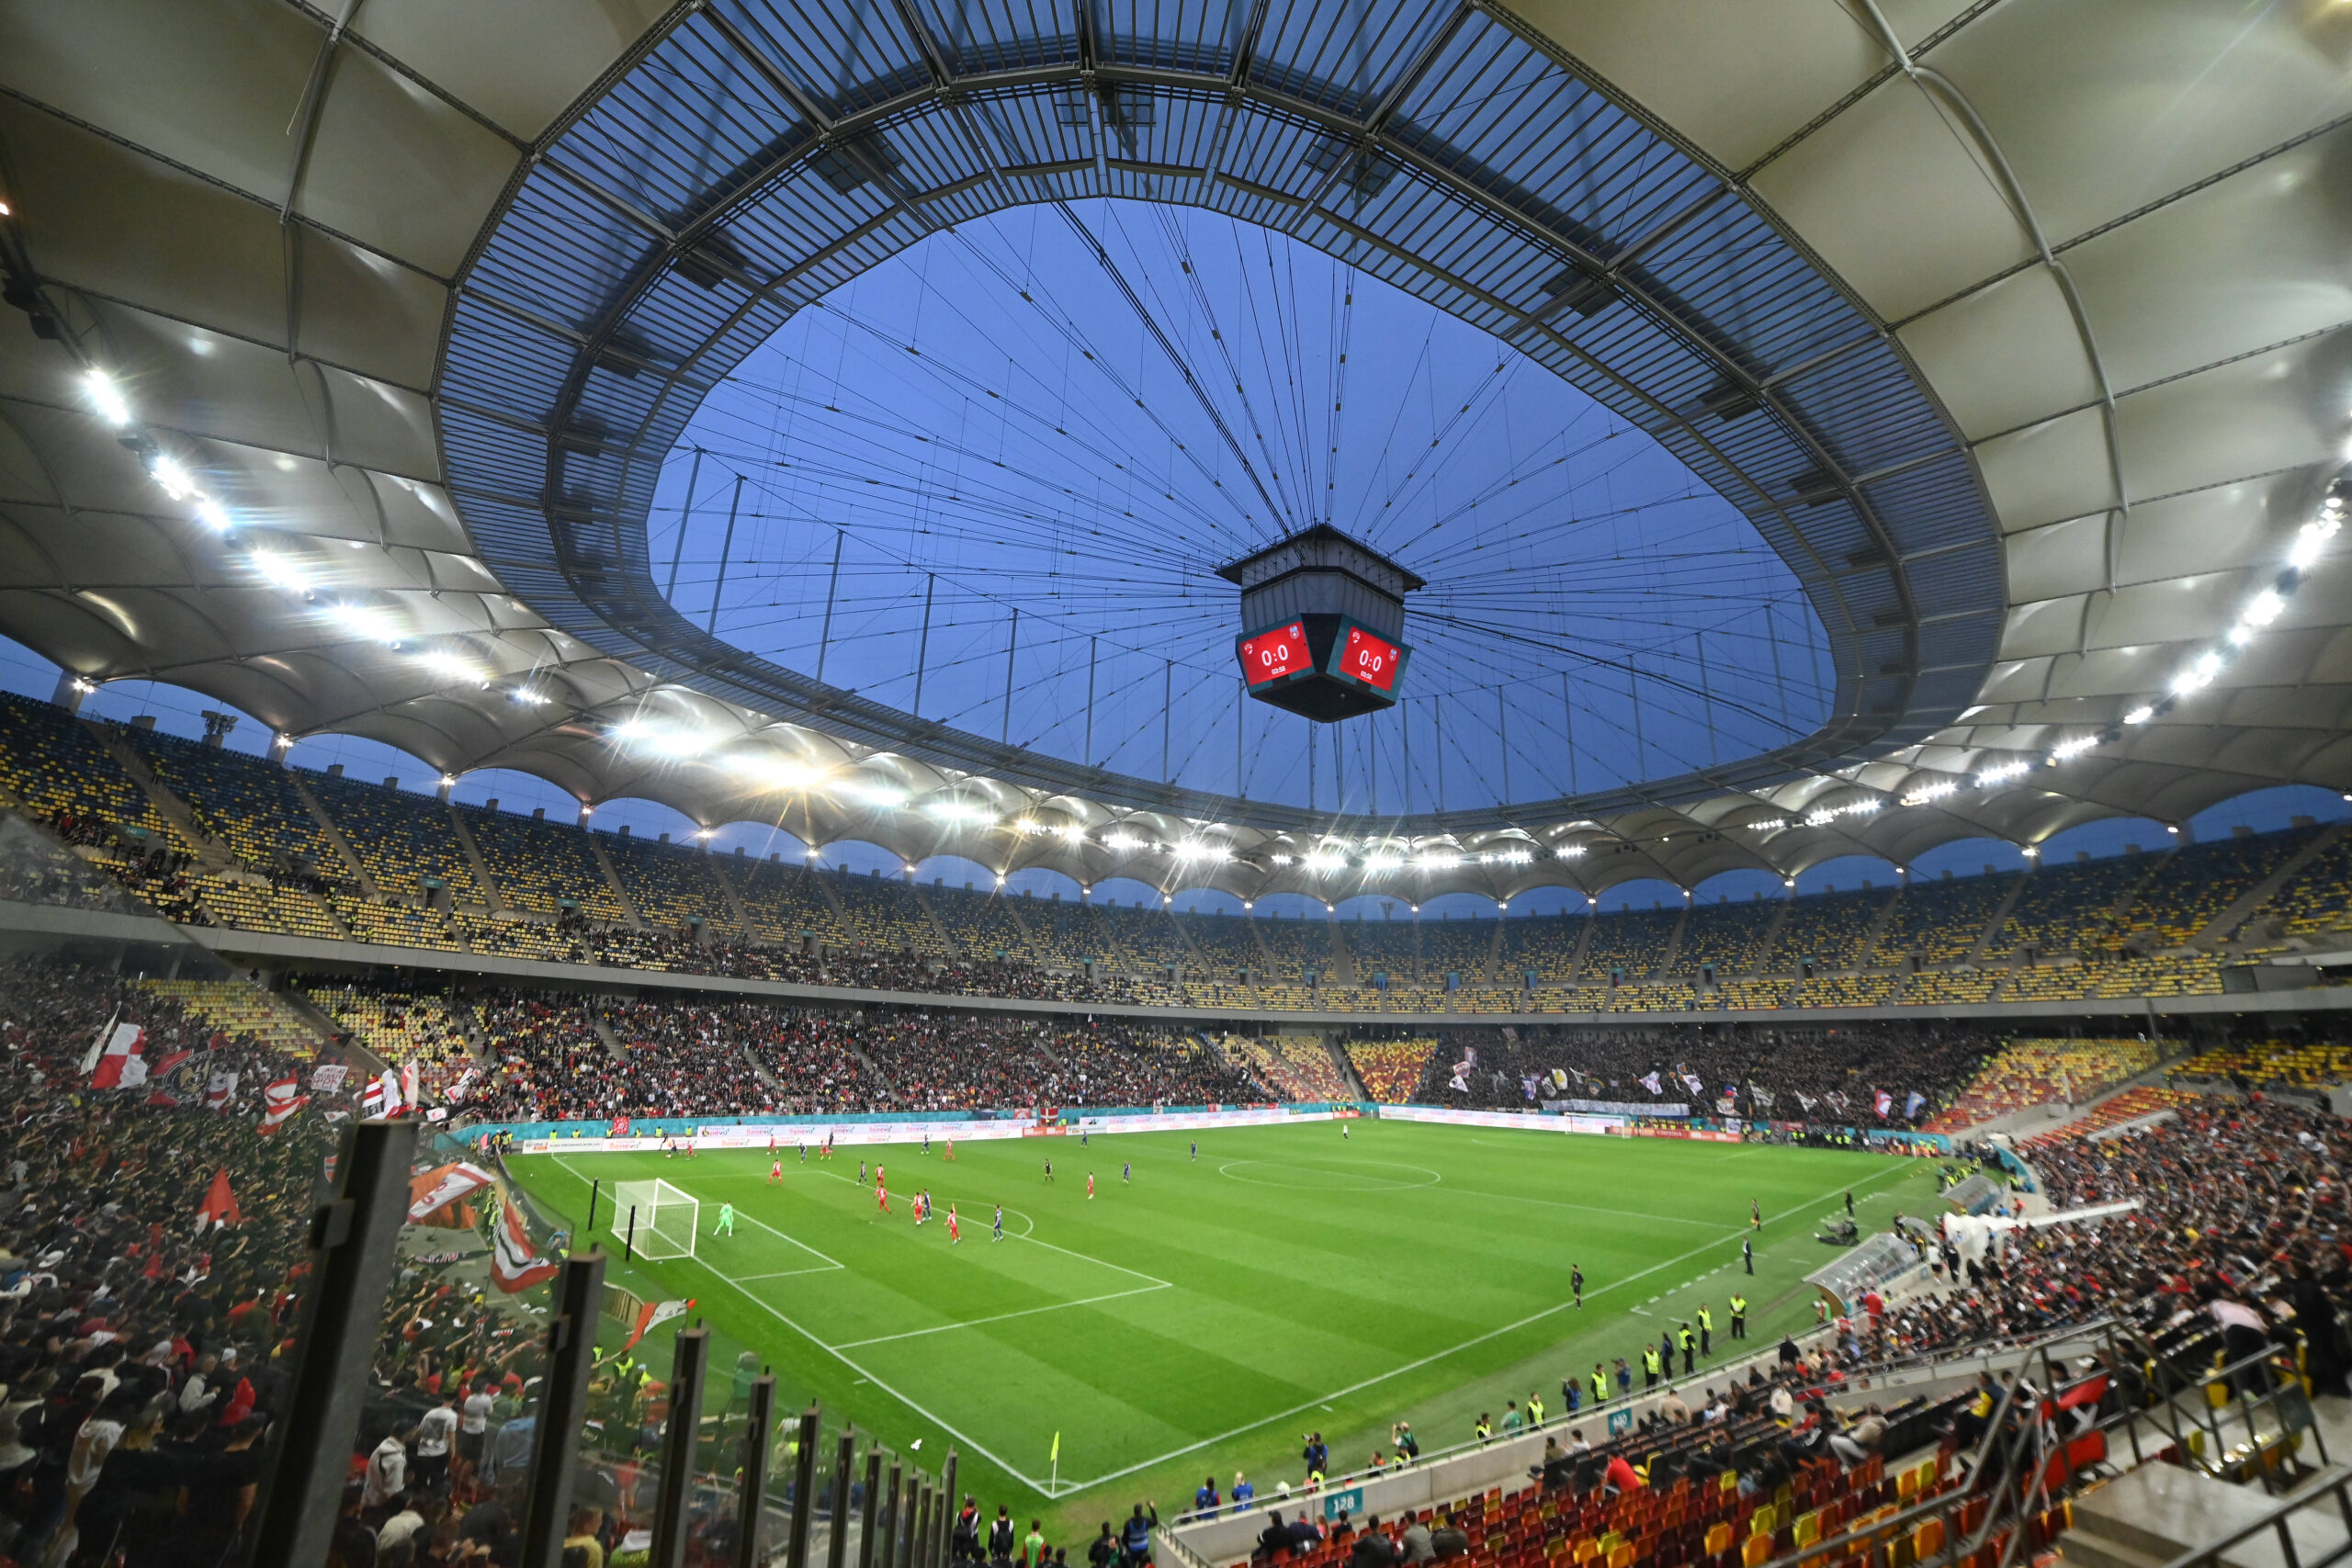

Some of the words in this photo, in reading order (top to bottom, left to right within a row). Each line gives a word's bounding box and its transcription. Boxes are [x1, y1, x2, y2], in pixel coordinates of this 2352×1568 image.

[1261, 644, 1289, 666] 0:0
[1360, 649, 1382, 671] 0:0
[1334, 1494, 1355, 1514] 128
